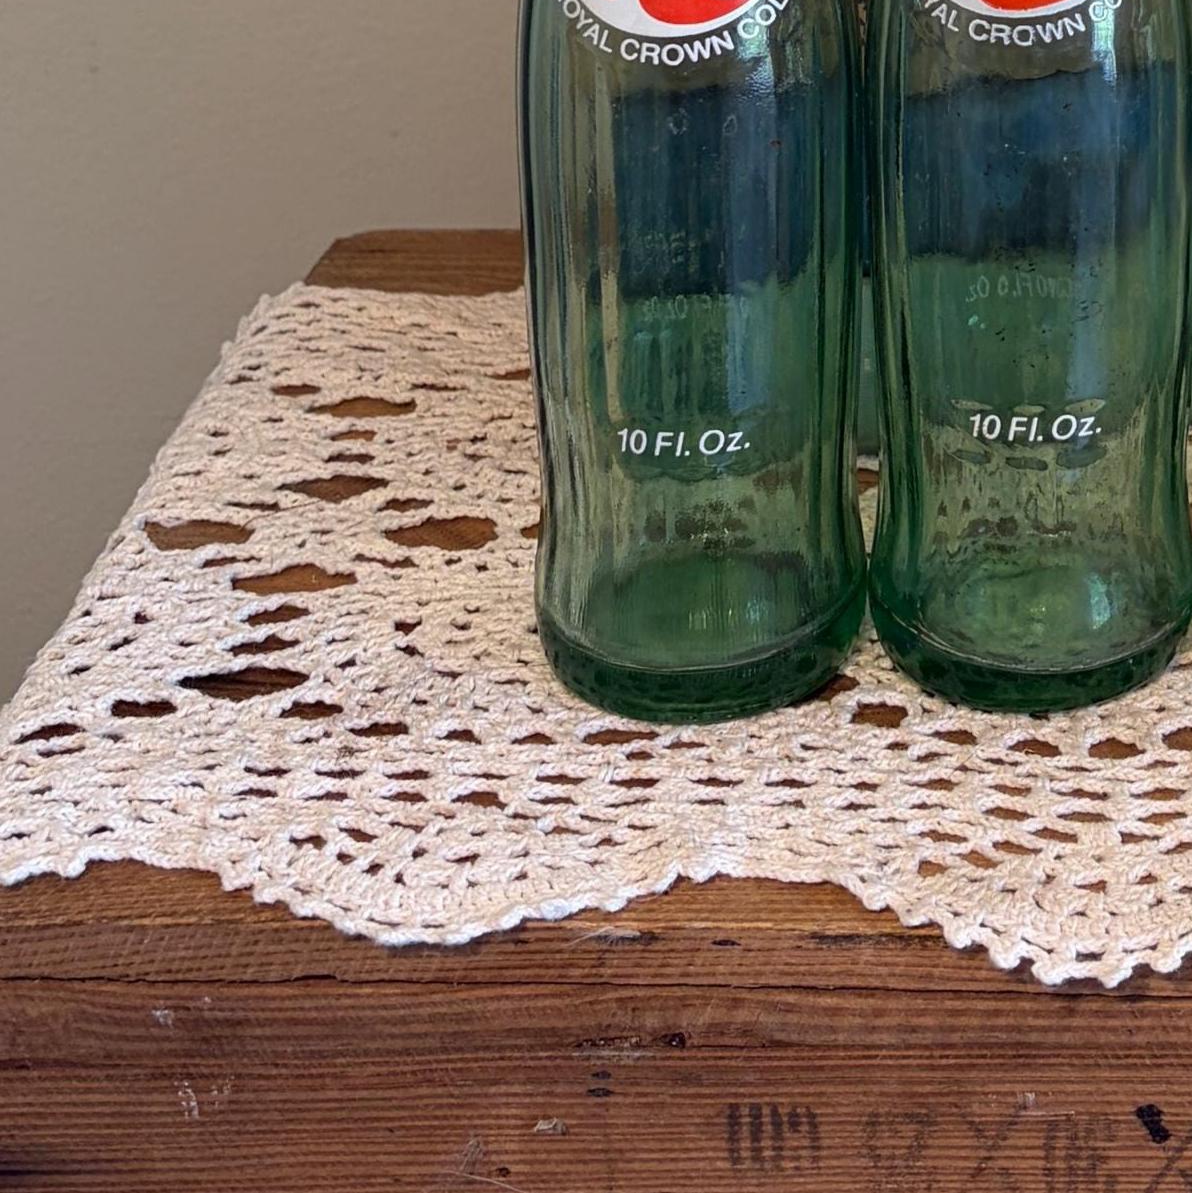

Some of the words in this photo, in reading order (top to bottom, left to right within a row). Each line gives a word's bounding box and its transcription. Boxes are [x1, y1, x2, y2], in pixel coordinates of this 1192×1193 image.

[968, 13, 1086, 46] CROWN
[620, 30, 734, 66] CROWN
[617, 427, 647, 454] 10
[699, 429, 750, 455] Oz.
[969, 413, 1001, 440] 10
[1051, 414, 1102, 440] Oz.
